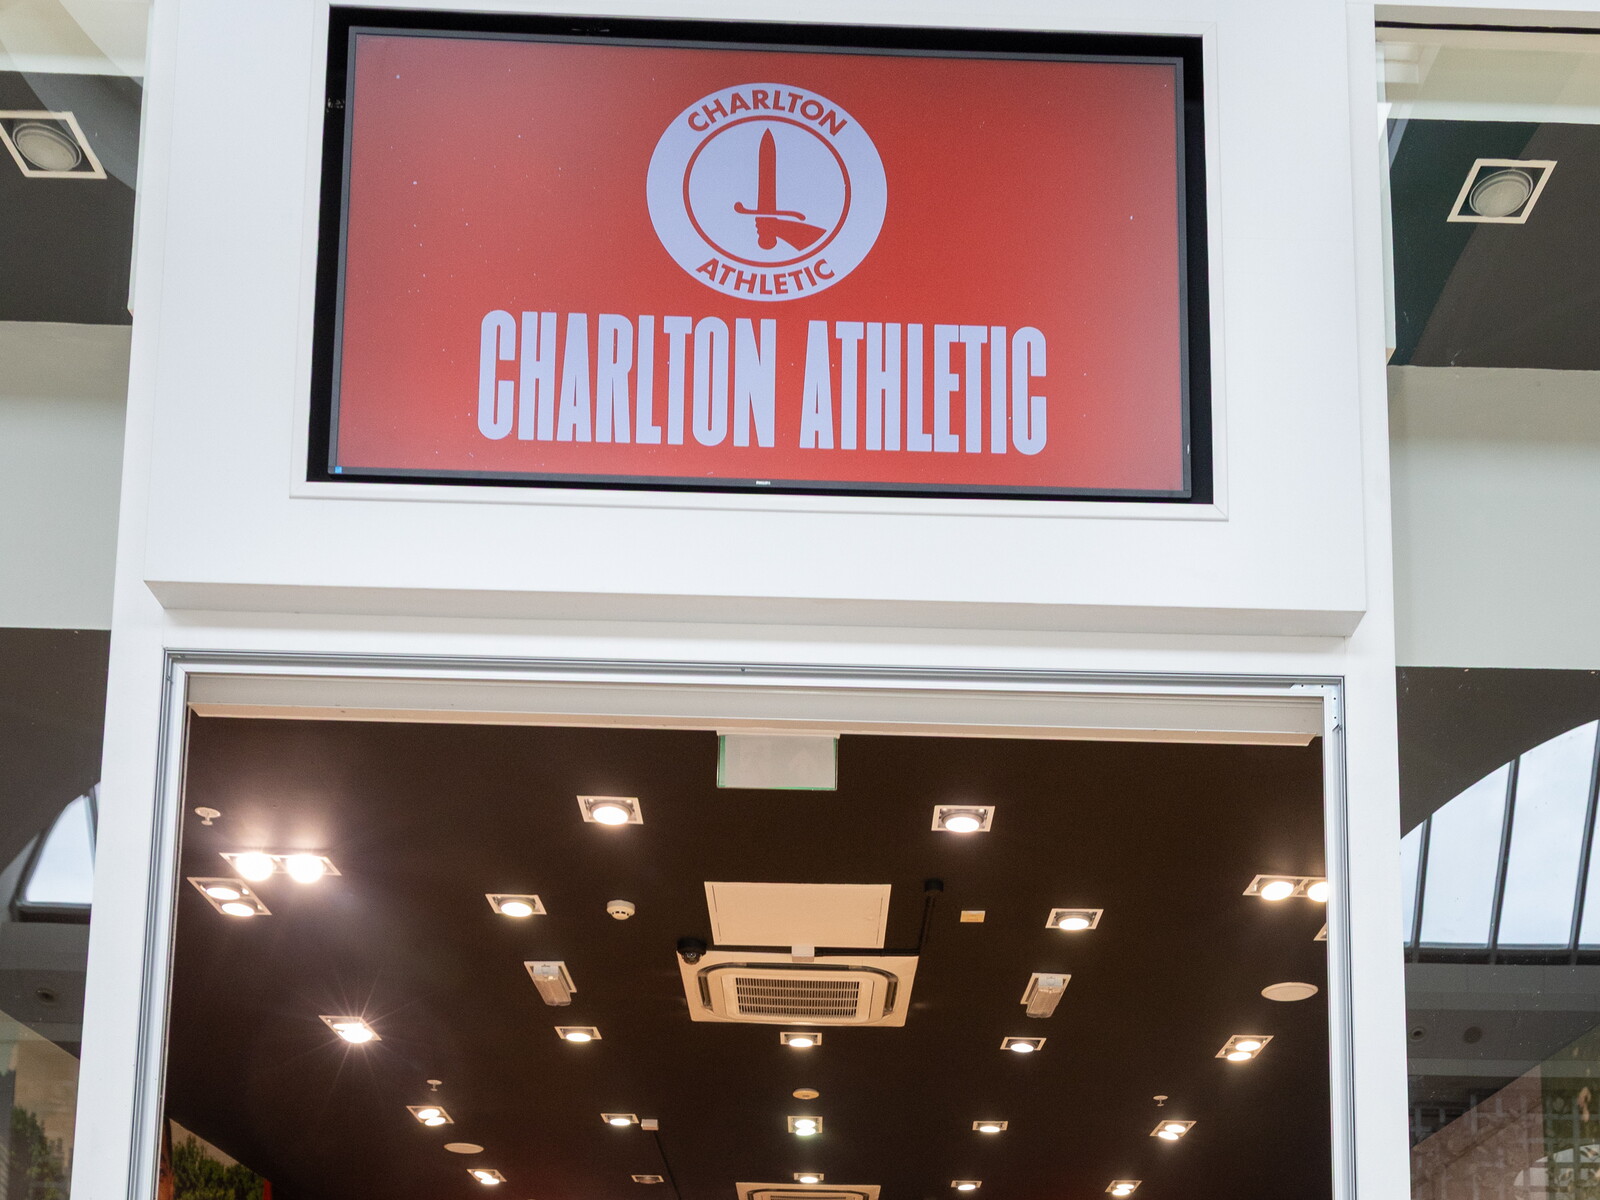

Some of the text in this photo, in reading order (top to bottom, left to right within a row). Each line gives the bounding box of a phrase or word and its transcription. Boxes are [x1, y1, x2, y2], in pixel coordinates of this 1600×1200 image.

[688, 89, 848, 137] CHARLTON
[695, 257, 835, 295] ATHLETIC
[478, 310, 1048, 456] CHARLTON ATHLETIC
